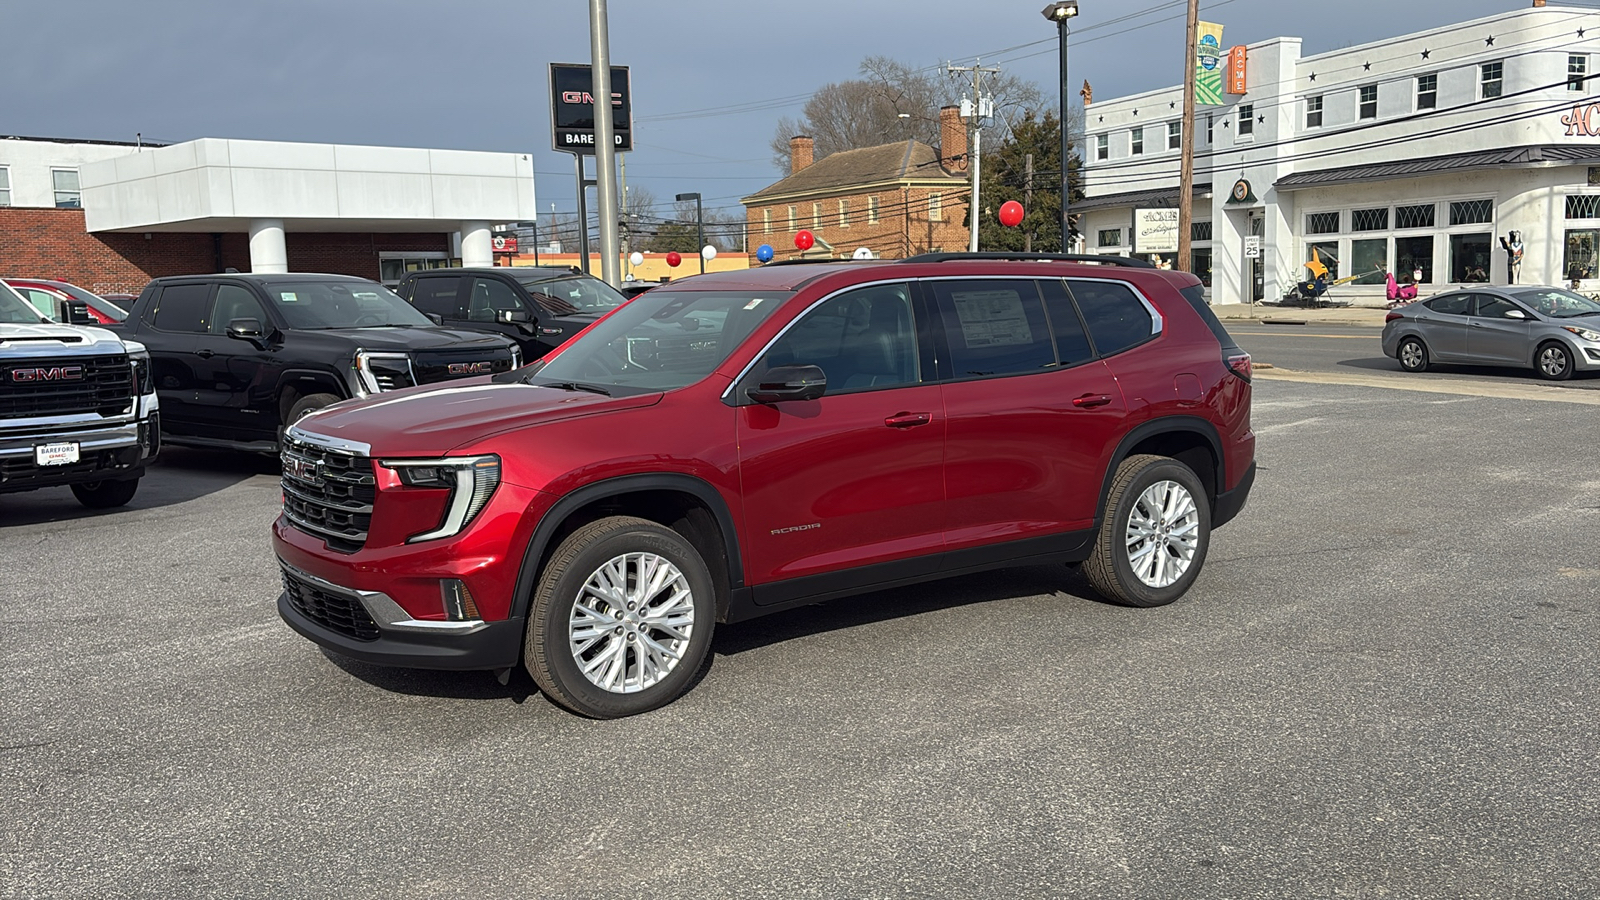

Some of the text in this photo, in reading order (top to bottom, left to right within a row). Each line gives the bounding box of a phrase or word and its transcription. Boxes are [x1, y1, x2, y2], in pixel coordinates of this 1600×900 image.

[1236, 49, 1244, 90] ACME
[1560, 103, 1600, 137] AC
[565, 134, 622, 144] BARED
[1246, 246, 1259, 256] 25
[12, 366, 83, 382] GMC
[447, 361, 492, 375] GMC
[41, 446, 75, 454] BAREFORD
[770, 522, 821, 535] ACADIA
